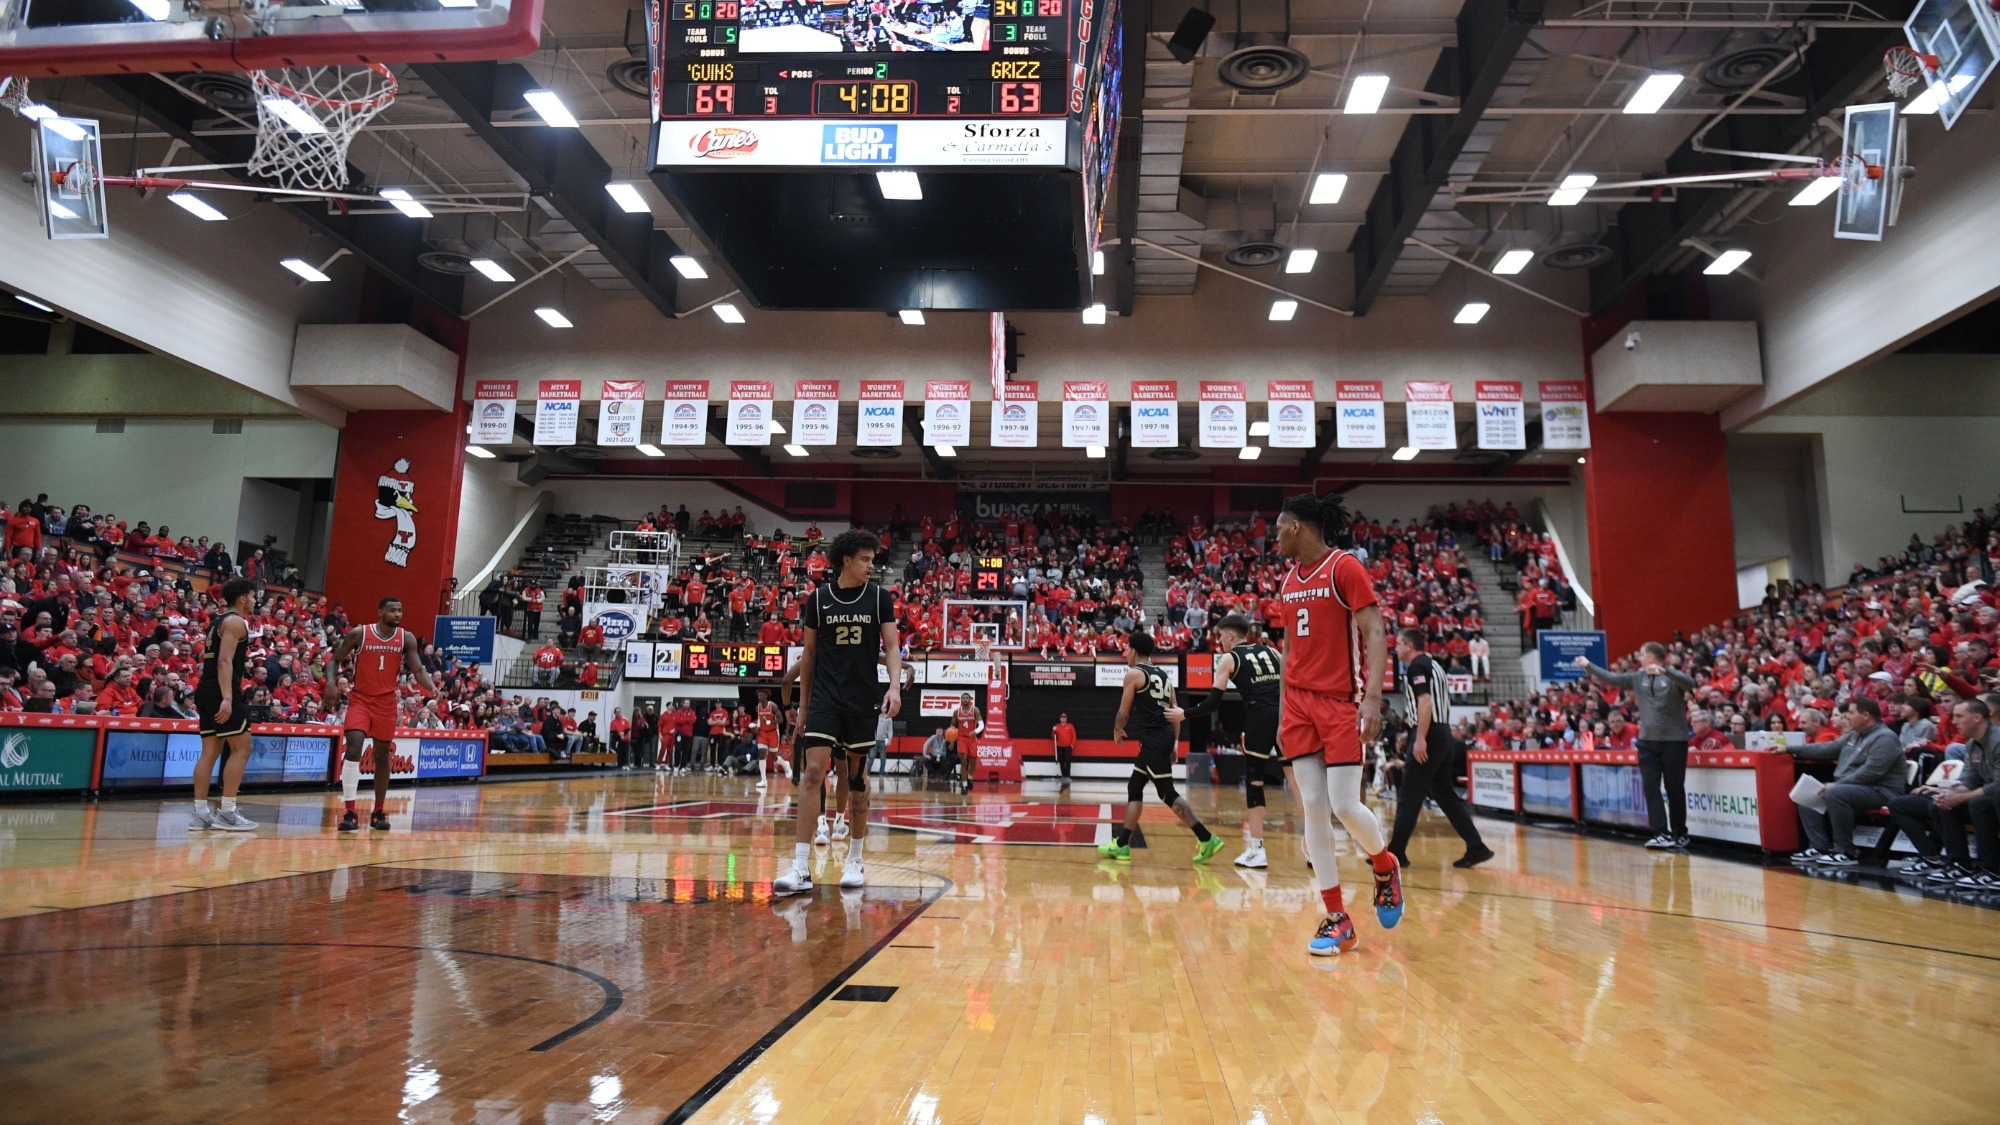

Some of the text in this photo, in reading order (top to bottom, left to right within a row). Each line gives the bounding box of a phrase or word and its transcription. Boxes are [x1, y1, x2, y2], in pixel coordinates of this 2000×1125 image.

[717, 4, 737, 18] 20
[996, 0, 1016, 16] 34
[1039, 0, 1061, 16] 20
[726, 28, 736, 42] 5
[1006, 26, 1016, 40] 3
[876, 64, 886, 78] 2
[992, 62, 1040, 78] GRIZZ
[696, 85, 733, 112] 69
[766, 98, 776, 112] 3
[840, 84, 908, 112] 4:08
[948, 98, 959, 112] 2
[1002, 84, 1040, 112] 63
[835, 128, 884, 144] BUD
[964, 124, 1040, 138] Sforza
[691, 130, 758, 158] Cane's
[942, 140, 1053, 152] & Carmella's
[824, 144, 893, 160] LIGHT
[865, 408, 894, 416] NCAA
[1138, 408, 1169, 417] NCAA
[1344, 409, 1374, 417] NCAA
[1482, 406, 1517, 417] WNIT
[980, 558, 1002, 568] 4:08
[978, 572, 998, 590] 29
[598, 617, 630, 626] Pizza
[826, 614, 872, 624] OAKLAND
[1296, 608, 1310, 636] 2
[602, 626, 628, 634] Joe's
[836, 626, 862, 645] 23
[541, 654, 554, 662] 20
[690, 654, 708, 668] 69
[722, 647, 756, 661] 4:08
[378, 656, 384, 670] 1
[765, 656, 782, 670] 63
[1245, 651, 1276, 675] 11
[739, 665, 746, 676] 2
[1150, 674, 1172, 699] 34
[270, 740, 328, 750] SOUTHWOODS
[421, 745, 459, 756] Northern Ohio
[130, 750, 201, 762] MEDICAL MUT
[284, 756, 314, 766] HEALTH
[420, 758, 458, 770] Honda Dealers
[12, 772, 61, 786] MUTUAL
[1688, 792, 1758, 816] ERCYHEALTH
